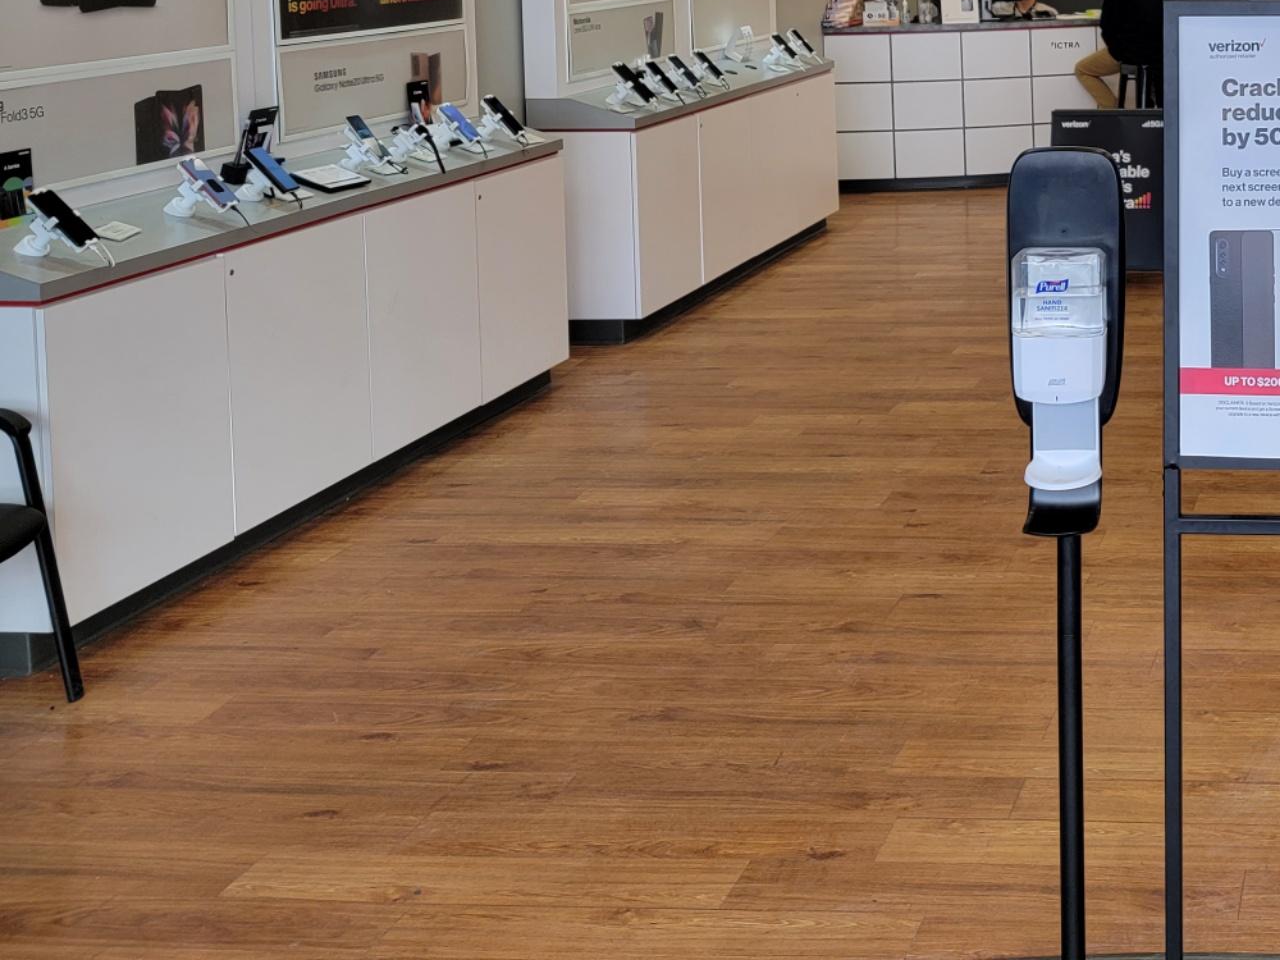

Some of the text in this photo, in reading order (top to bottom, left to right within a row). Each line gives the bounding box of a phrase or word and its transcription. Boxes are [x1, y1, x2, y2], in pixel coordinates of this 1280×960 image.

[288, 0, 299, 13] is
[1208, 40, 1260, 52] verizon
[313, 67, 346, 81] SAMSUNG
[29, 106, 45, 119] 5G
[1061, 120, 1089, 128] verizon
[1222, 127, 1250, 149] by
[1221, 167, 1242, 178] Buy
[1222, 182, 1246, 192] next
[1222, 197, 1233, 207] to
[1243, 198, 1266, 207] new
[1224, 376, 1239, 386] UP
[1240, 376, 1256, 386] TO
